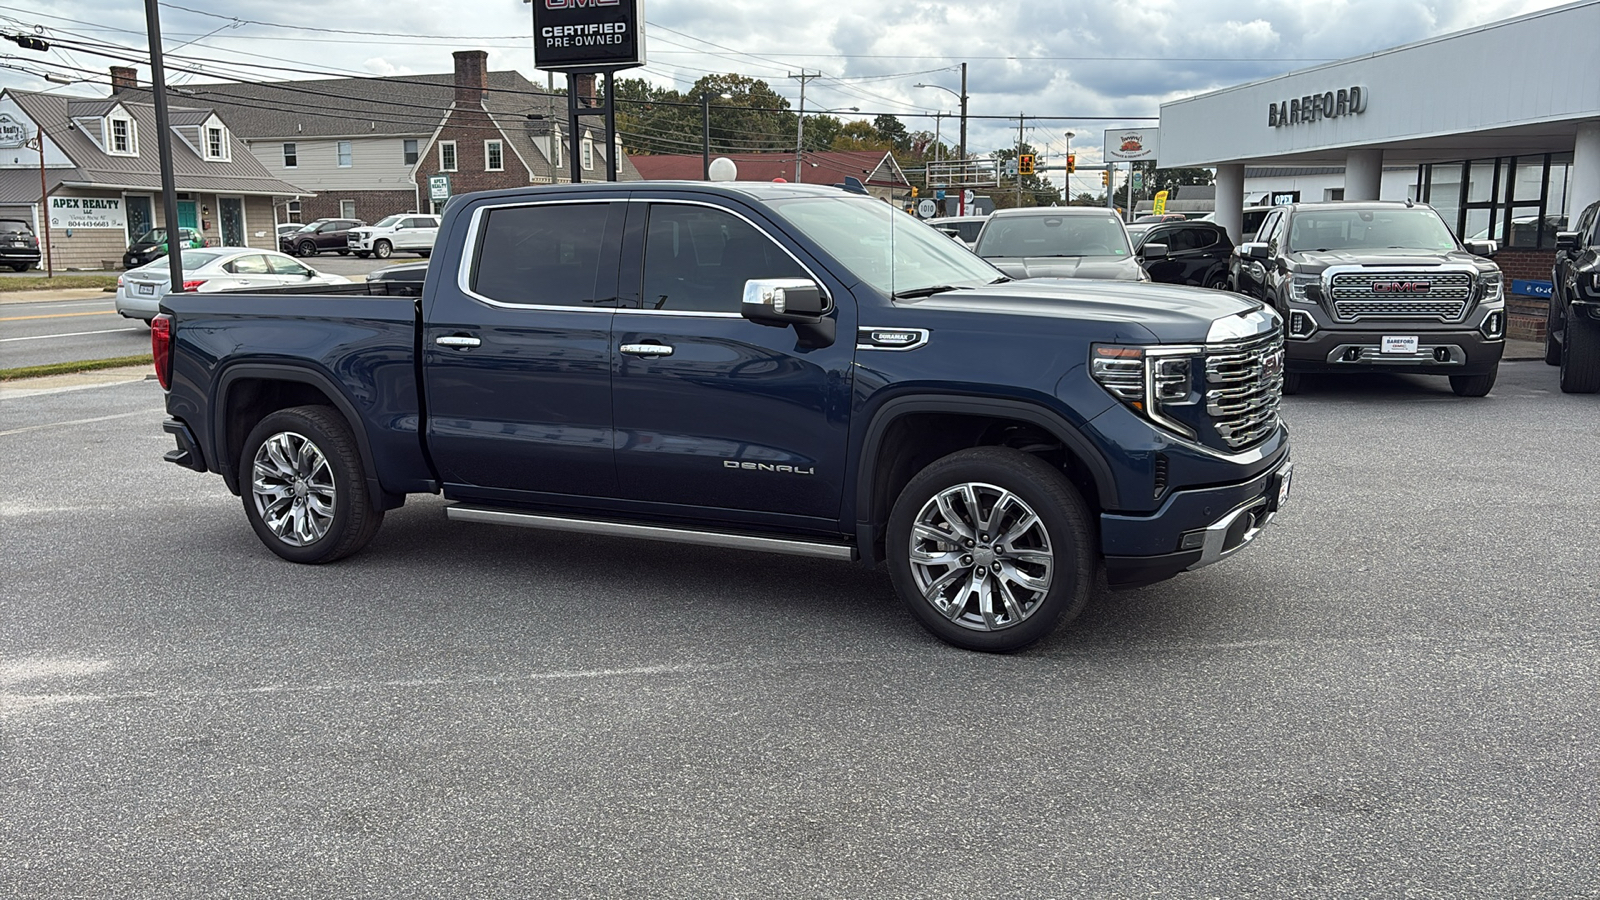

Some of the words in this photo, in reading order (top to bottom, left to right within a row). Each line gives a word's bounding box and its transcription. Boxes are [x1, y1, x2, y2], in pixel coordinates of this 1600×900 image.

[542, 22, 626, 37] CERTIFIED
[546, 34, 622, 48] PRE-OWNED
[1268, 86, 1367, 127] BAREFORD
[53, 198, 80, 208] APEX
[82, 199, 119, 209] REALTY
[1275, 194, 1293, 205] OPEN
[920, 204, 934, 213] 1010
[1373, 282, 1430, 292] GMC
[723, 460, 815, 475] DENALI
